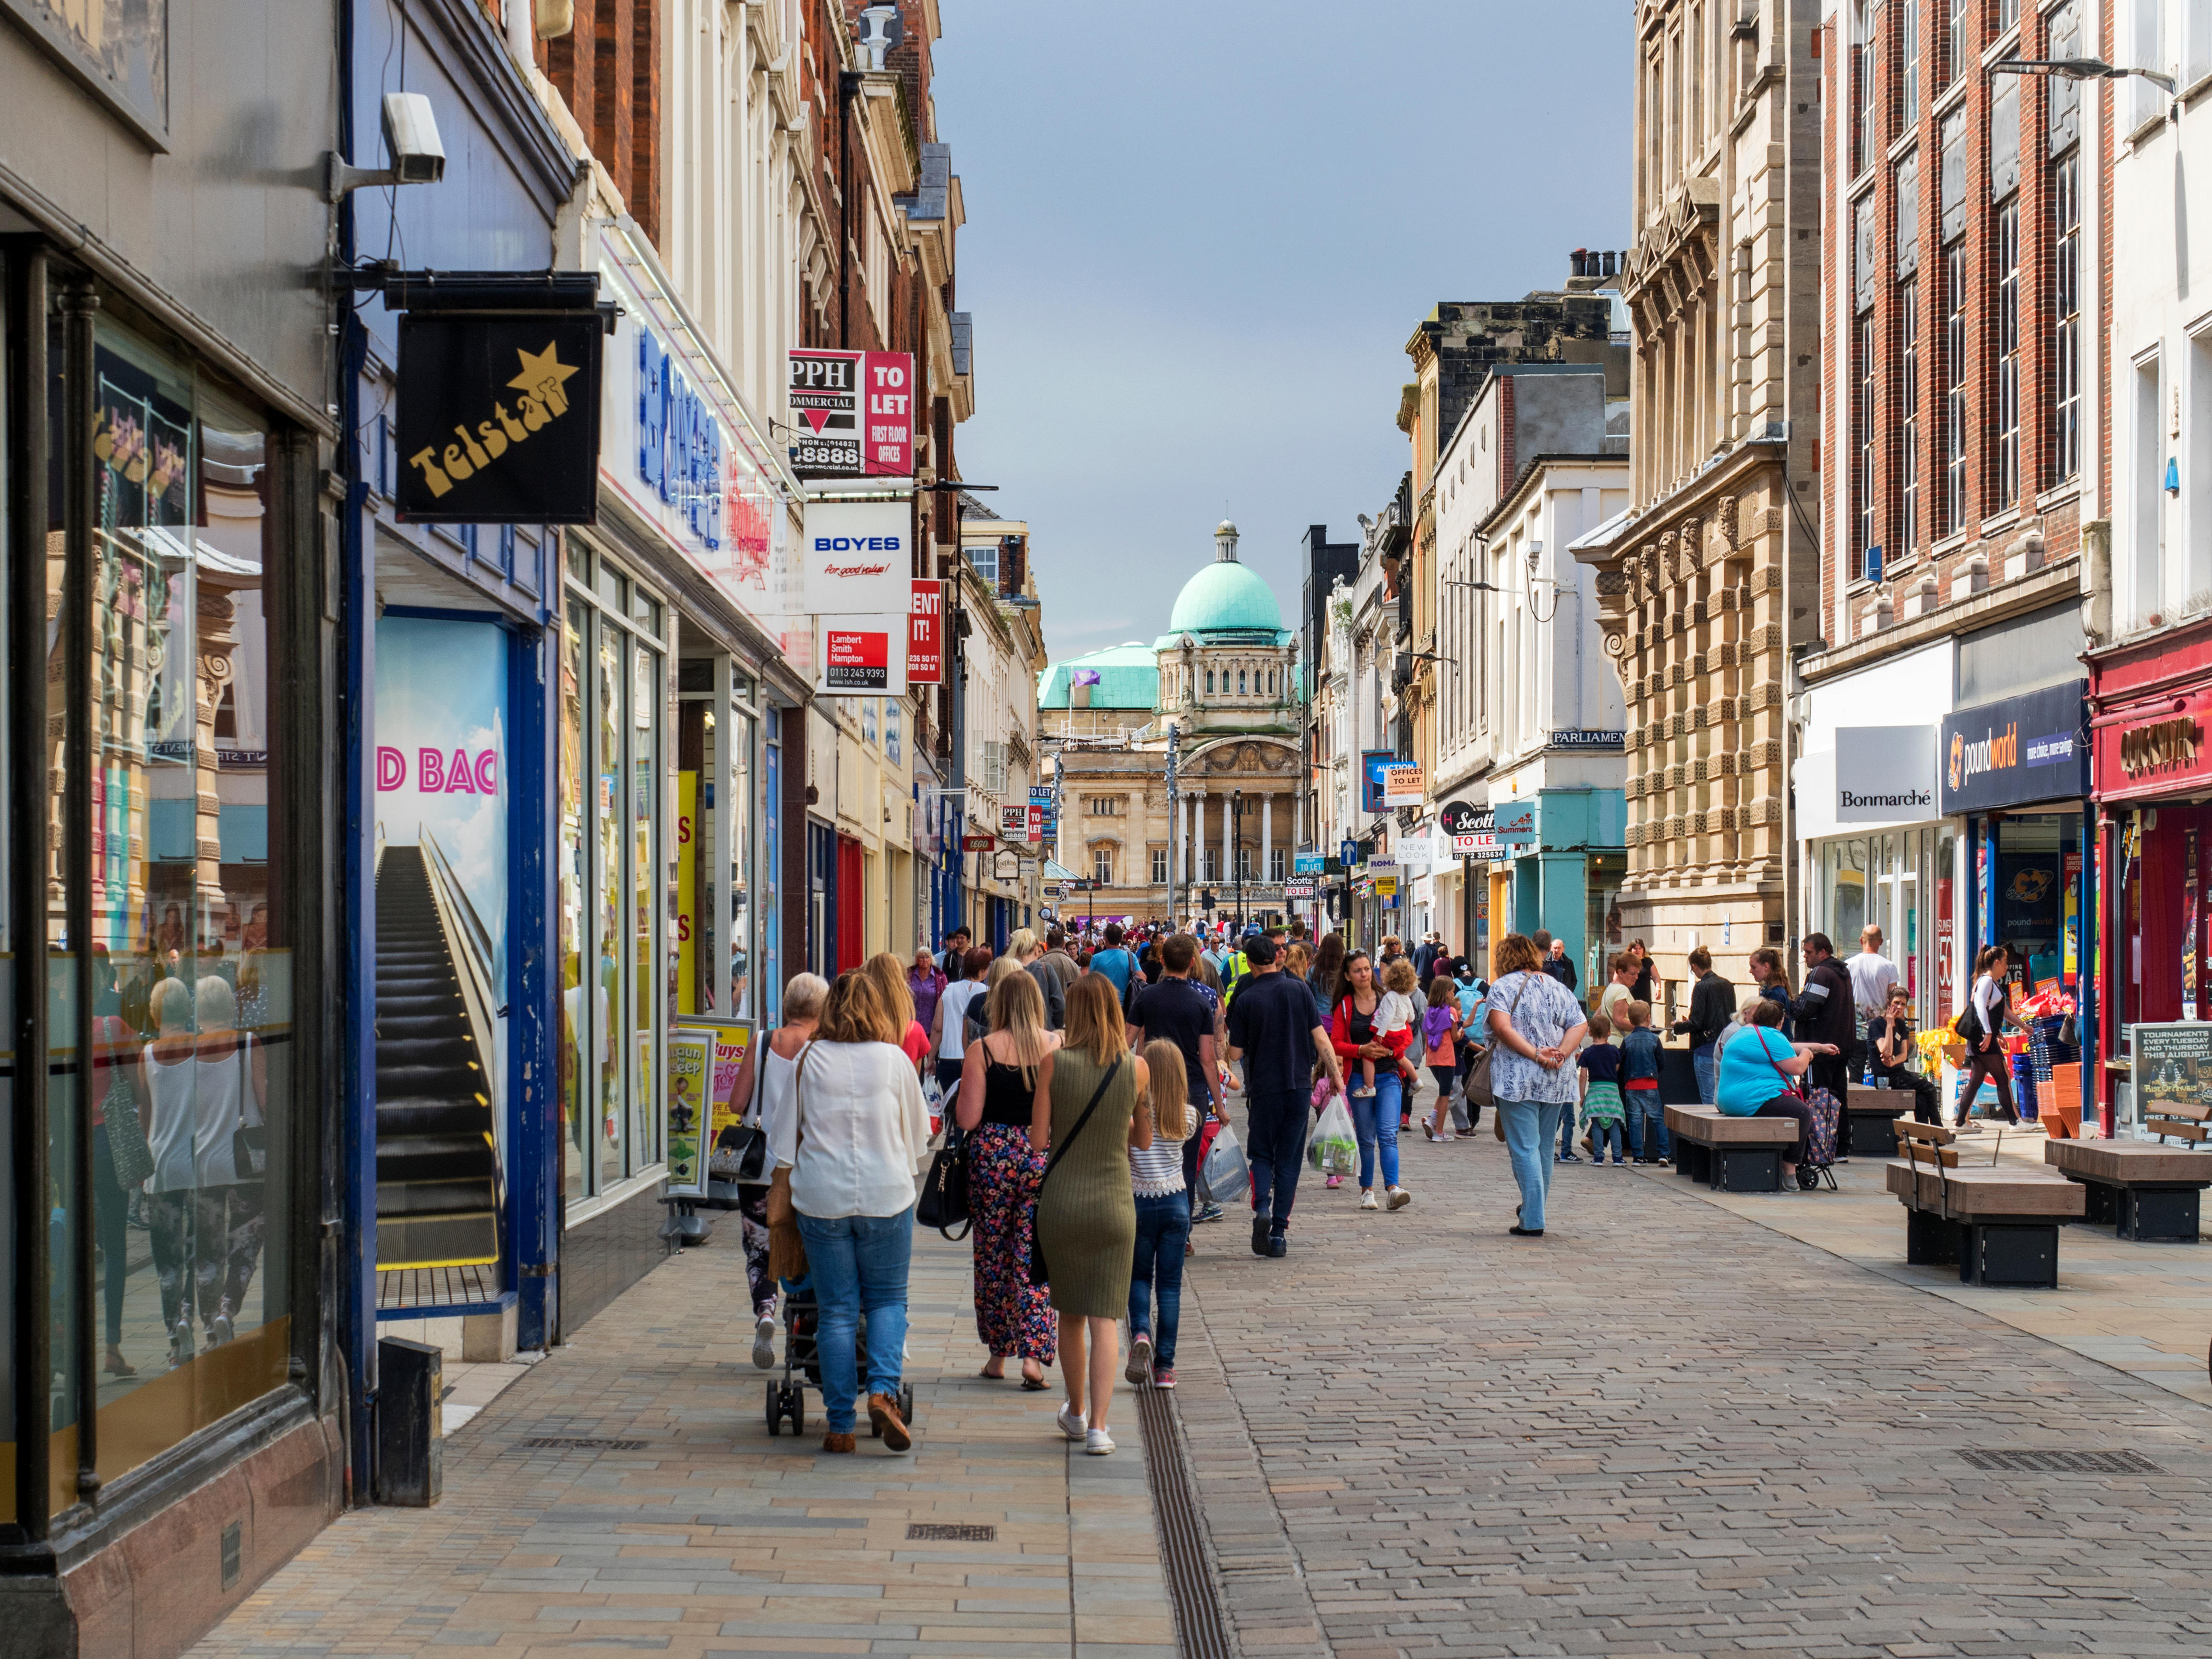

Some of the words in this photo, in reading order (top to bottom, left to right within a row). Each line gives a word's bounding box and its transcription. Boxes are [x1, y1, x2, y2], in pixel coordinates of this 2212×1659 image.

[790, 361, 848, 388] PPH
[874, 367, 904, 387] TO
[871, 394, 908, 414] LET
[409, 376, 570, 498] Telstar
[872, 426, 887, 443] FIRST
[888, 426, 907, 443] FLOOR
[878, 446, 901, 462] OFFICES
[815, 537, 900, 551] BOYES
[824, 564, 840, 574] for
[839, 563, 864, 576] good
[911, 593, 939, 614] ENT
[914, 620, 930, 641] IT!
[831, 635, 862, 644] Lambert
[831, 644, 853, 653] Smith
[831, 654, 864, 664] Hampton
[830, 668, 849, 677] 0113
[851, 669, 865, 678] 245
[866, 669, 885, 678] 9393
[1965, 721, 2017, 786] poundworld
[2027, 746, 2037, 760] more
[1039, 788, 1050, 796] LET
[1841, 790, 1931, 807] Bonmarché
[1003, 808, 1022, 817] PPH
[1031, 813, 1041, 822] TO
[1510, 817, 1533, 827] Ann
[1030, 825, 1042, 833] LET
[1455, 836, 1474, 846] TO
[1478, 835, 1496, 845] LE
[1477, 851, 1503, 859] 325634
[1286, 877, 1312, 885] Scotts
[2008, 917, 2053, 927] poundworld
